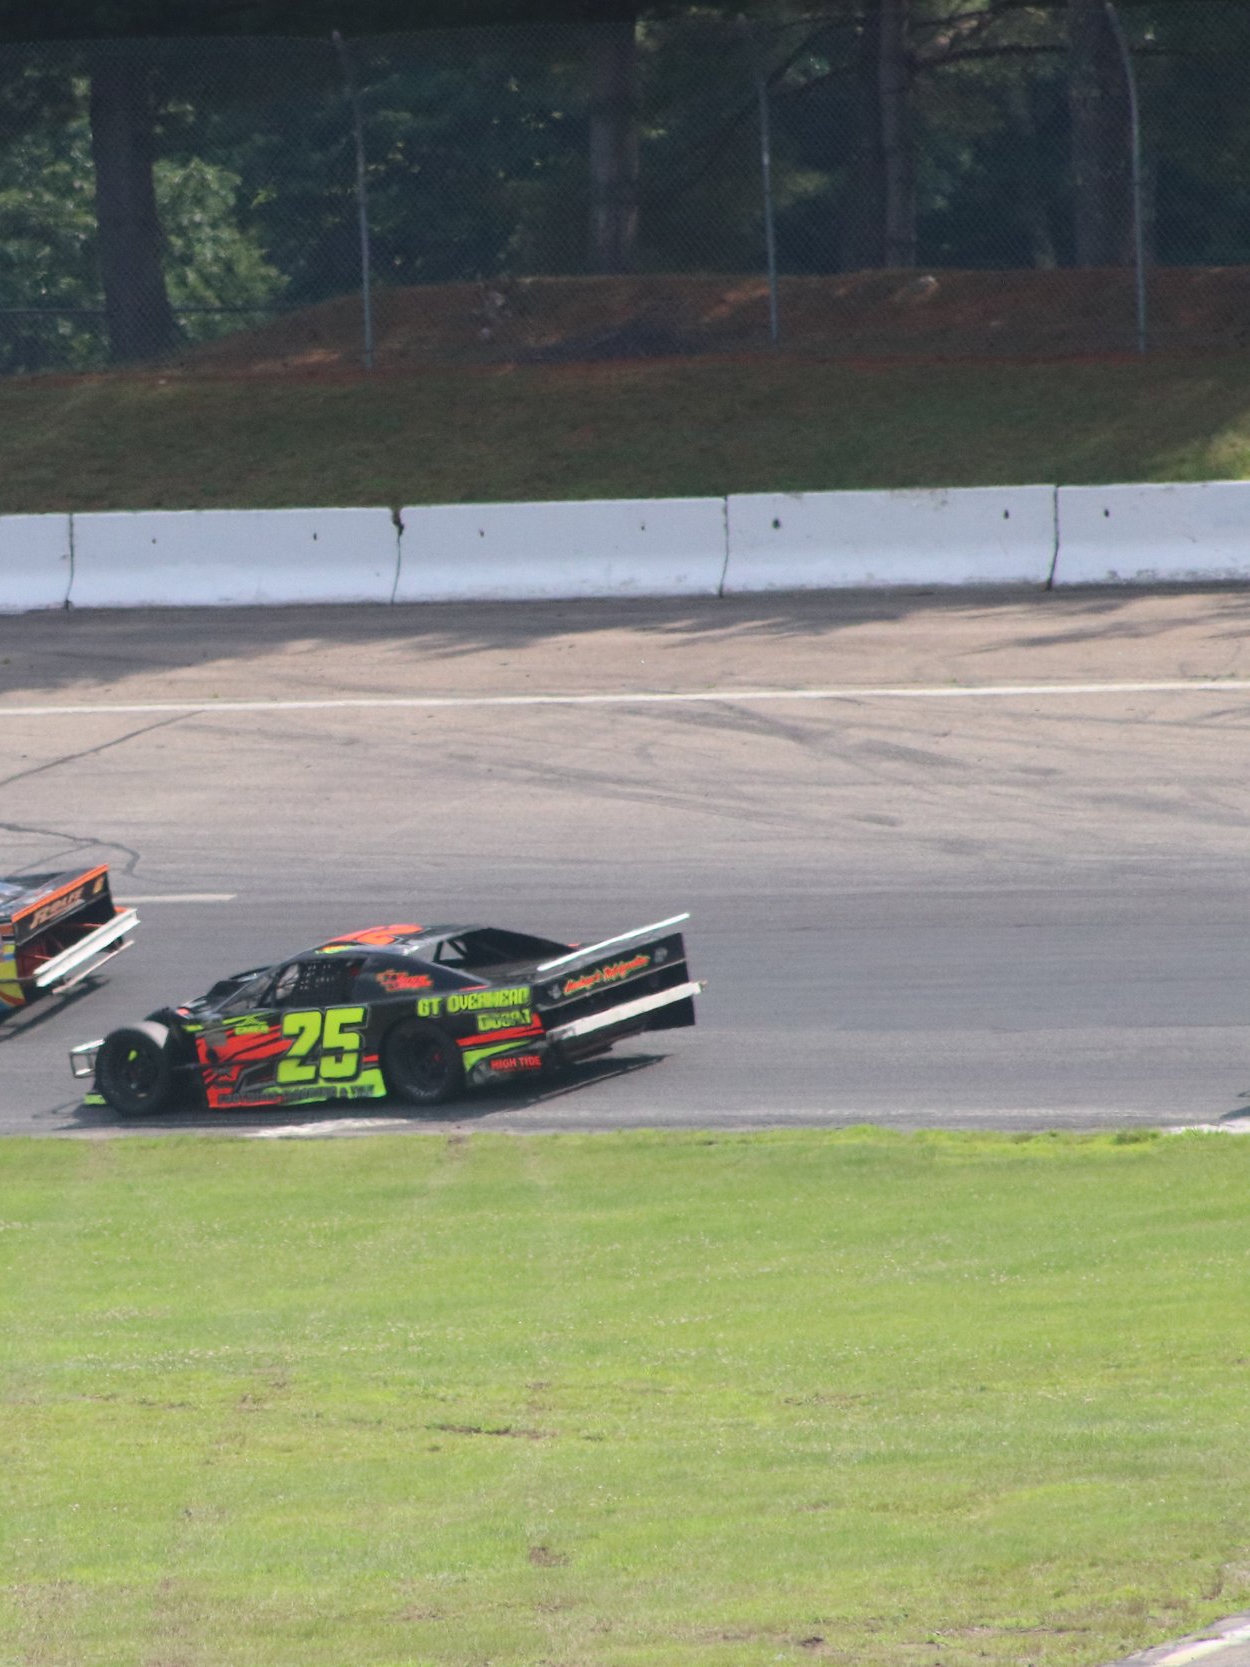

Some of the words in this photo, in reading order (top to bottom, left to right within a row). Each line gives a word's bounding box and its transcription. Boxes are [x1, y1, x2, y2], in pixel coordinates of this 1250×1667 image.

[417, 997, 442, 1017] GT
[276, 1006, 366, 1083] 25
[490, 1057, 517, 1070] HIGH
[518, 1055, 542, 1067] TIDE
